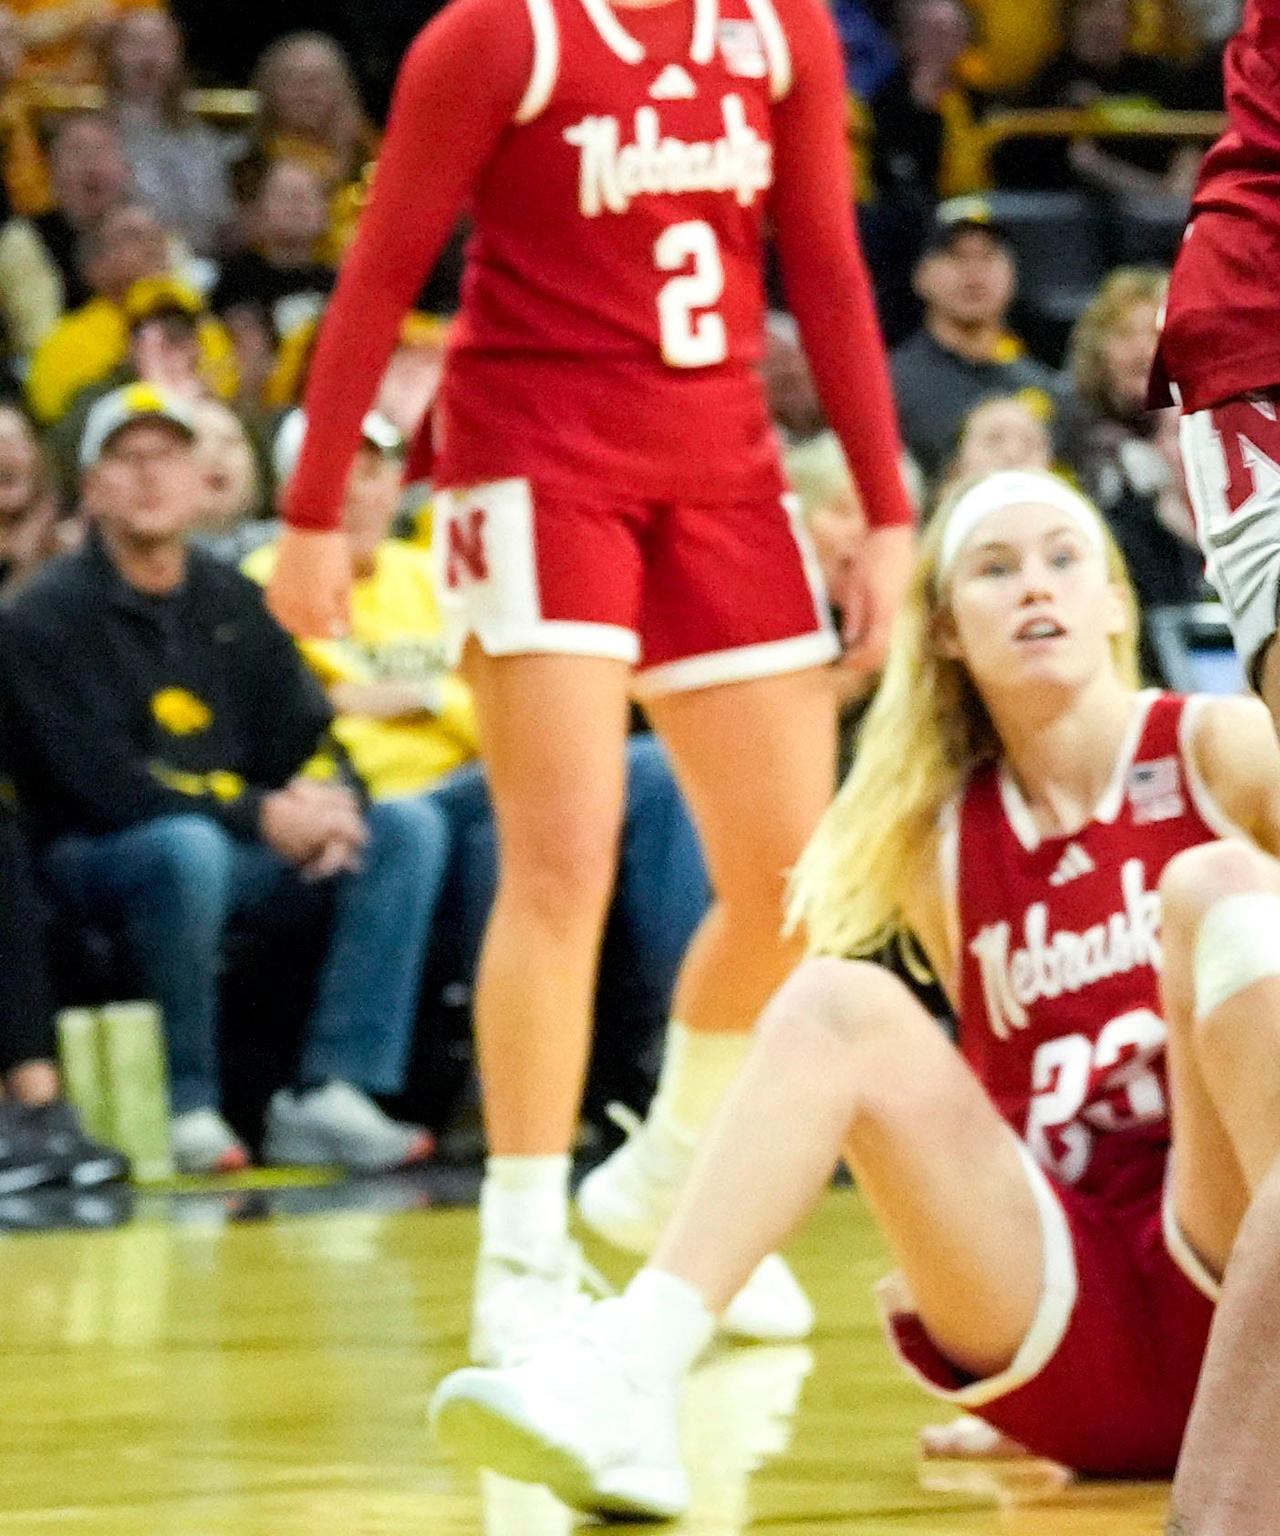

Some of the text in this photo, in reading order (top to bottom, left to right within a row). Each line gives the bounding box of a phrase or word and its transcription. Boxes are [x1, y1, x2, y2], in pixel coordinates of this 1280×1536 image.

[653, 218, 728, 368] 2
[446, 508, 488, 588] N
[968, 856, 1164, 1041] Nebrask
[1024, 1008, 1170, 1185] 23
